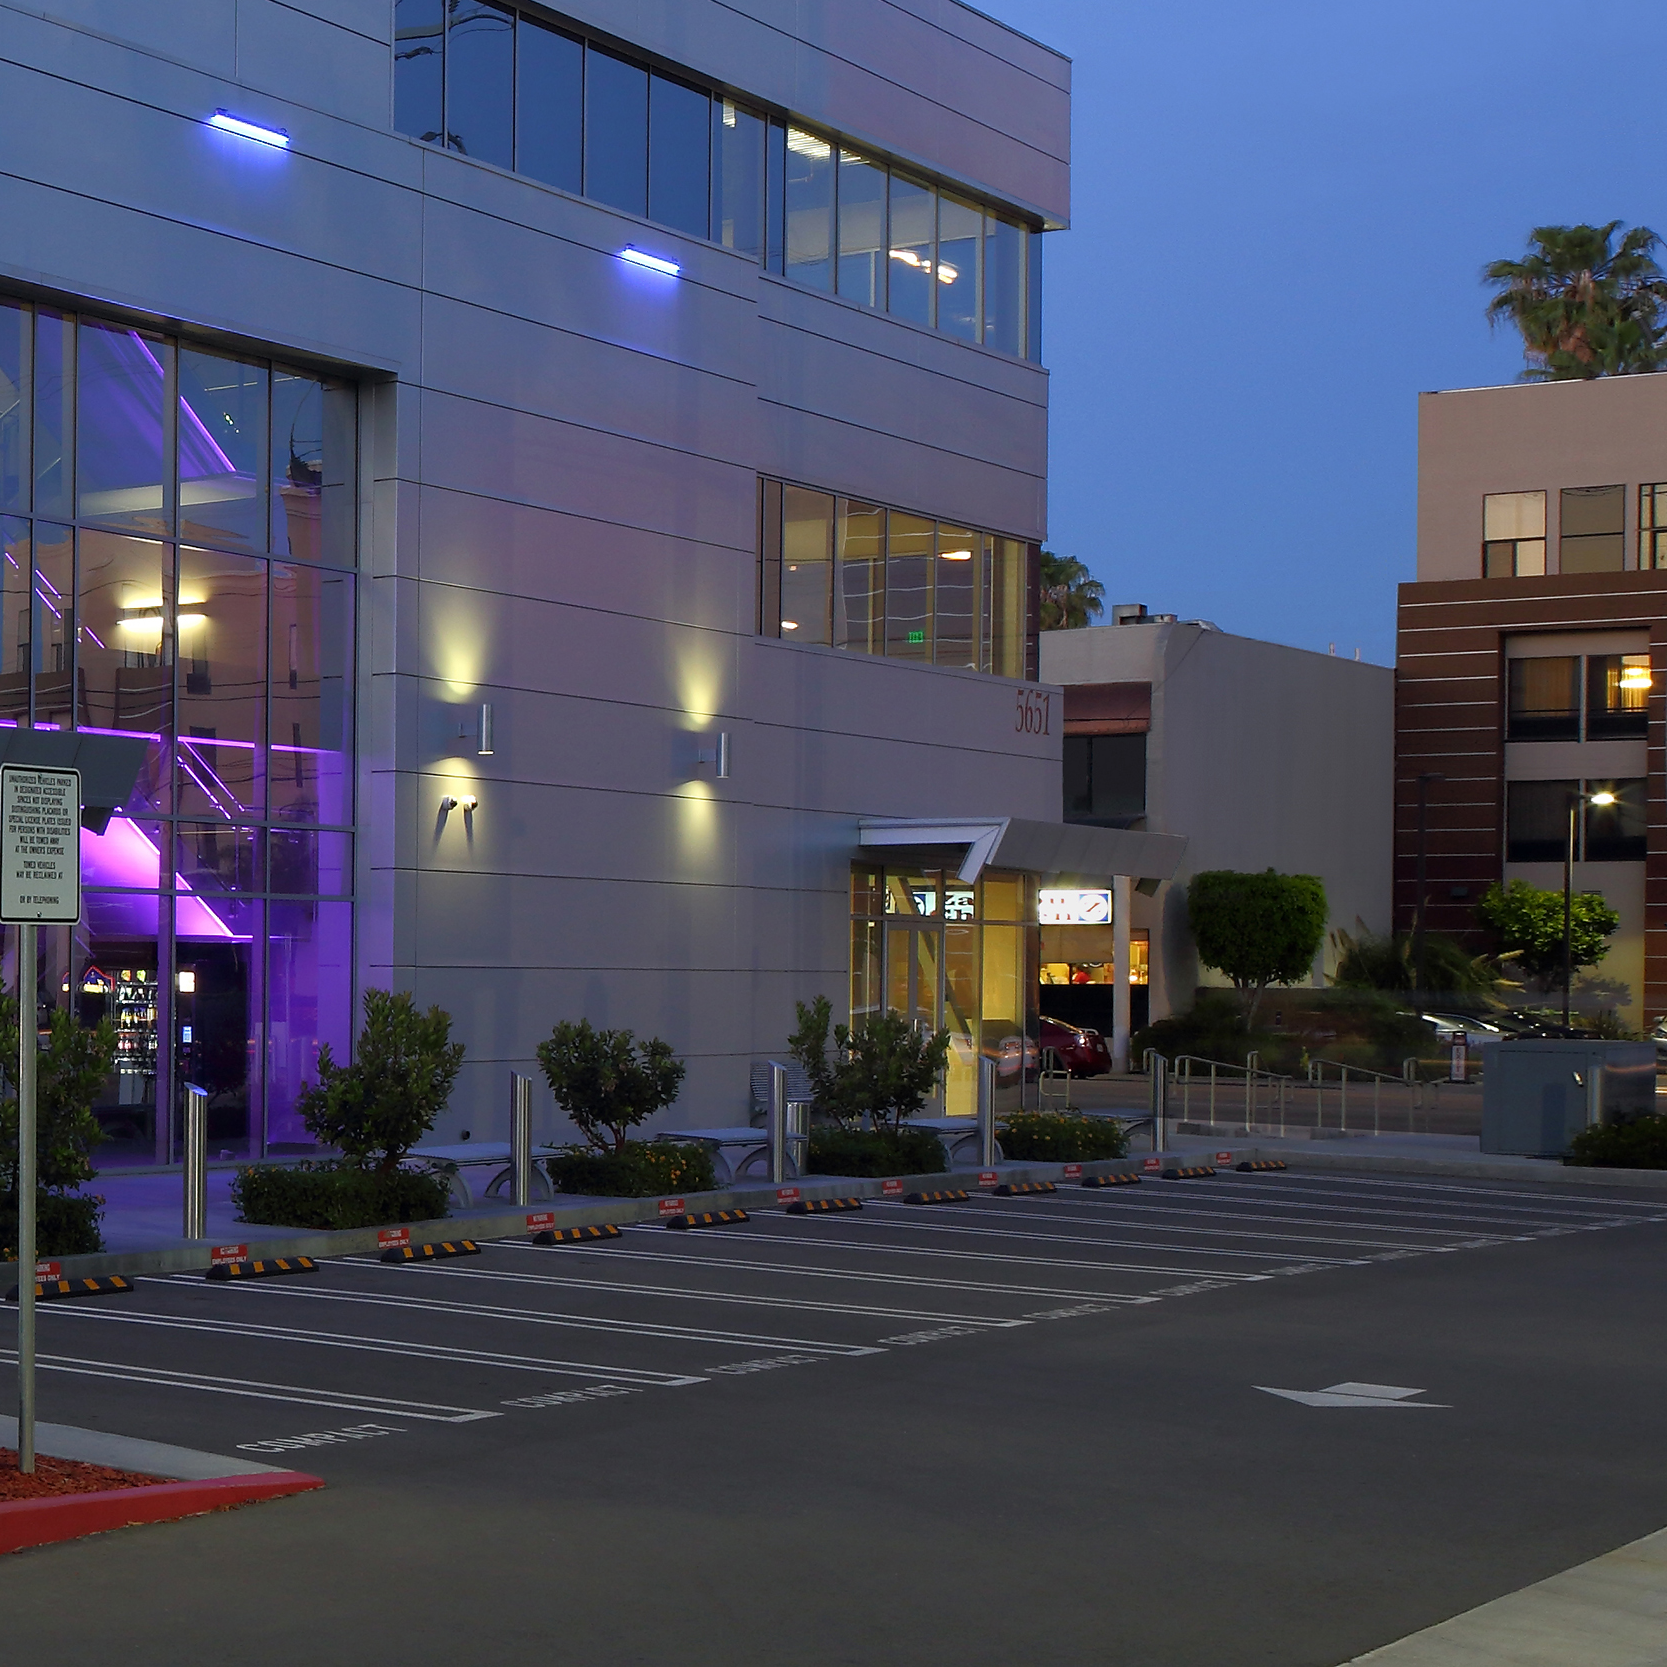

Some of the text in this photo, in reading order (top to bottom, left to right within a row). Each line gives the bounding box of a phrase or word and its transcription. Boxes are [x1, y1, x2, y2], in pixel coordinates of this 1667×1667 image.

[1016, 688, 1049, 735] 5651
[18, 826, 35, 834] PERSONS
[47, 847, 64, 855] EXPENSE
[24, 860, 55, 869] TOWED VEHICLES
[33, 895, 59, 904] TELEPHONING
[499, 1384, 644, 1409] COMPACT
[235, 1423, 408, 1453] COMPACT
